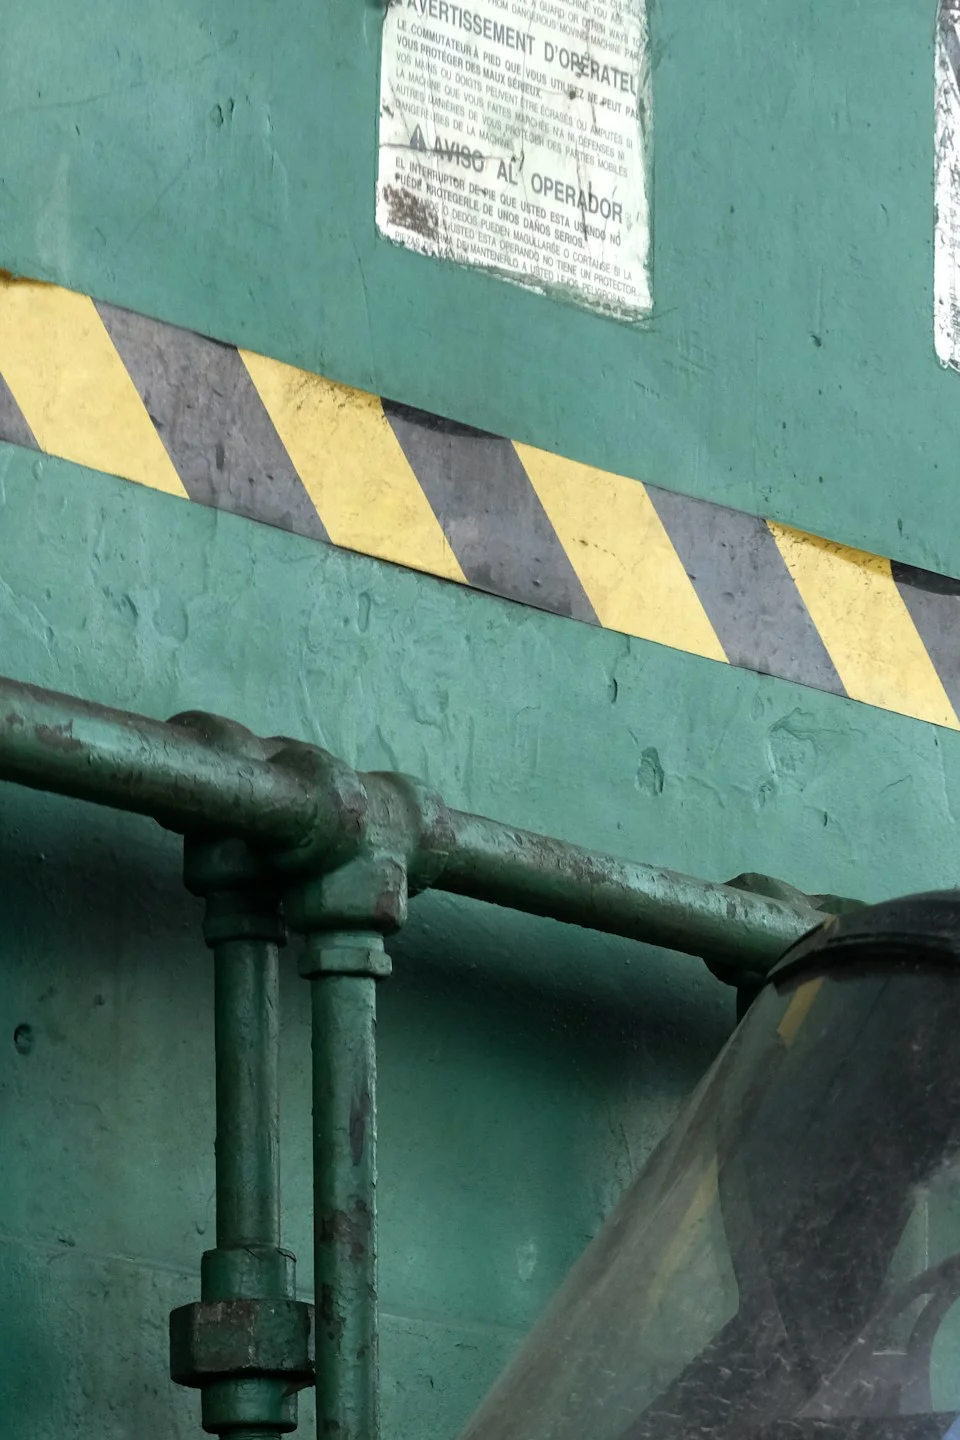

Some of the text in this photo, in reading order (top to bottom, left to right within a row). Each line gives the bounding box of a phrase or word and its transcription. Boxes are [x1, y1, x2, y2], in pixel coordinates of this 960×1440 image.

[512, 2, 555, 29] DANGEROUS
[539, 0, 564, 19] GUARD
[568, 10, 577, 25] OR
[396, 48, 410, 65] VOS
[415, 55, 436, 75] MAINS
[440, 65, 451, 81] OU
[455, 71, 481, 92] DOIGTS
[485, 83, 517, 106] PEUVENT
[576, 118, 586, 133] OU
[397, 32, 417, 52] VOUS
[420, 41, 462, 69] PROTÉGER
[465, 59, 480, 76] DES
[483, 66, 504, 86] MAUX
[397, 17, 620, 114] LE COMMUTATEUR À PIED QUE VOUS UTILISEZ NE PEUT
[396, 65, 404, 79] LA
[444, 84, 459, 100] QUE
[463, 91, 483, 109] VOUS
[487, 100, 511, 119] FAITES
[568, 131, 574, 144] NI
[618, 150, 624, 163] NI
[396, 81, 424, 102] AUTRES
[468, 108, 477, 122] DE
[481, 113, 501, 131] VOUS
[547, 139, 561, 154] DES
[598, 157, 627, 179] MOBILES
[453, 119, 462, 132] DE
[466, 123, 475, 137] LA
[395, 155, 404, 169] EL
[409, 160, 464, 190] INTERRUPTOR
[469, 181, 479, 195] DE
[485, 187, 495, 201] PIE
[500, 192, 516, 208] QUE
[520, 199, 545, 219] USTED
[550, 210, 569, 227] ESTA
[574, 219, 605, 240] USANDO
[433, 133, 622, 224] AVISO AL OPERADOR
[450, 222, 474, 240] USTED
[478, 231, 495, 247] ESTA
[499, 239, 539, 263] OPERANDO
[543, 254, 552, 267] NO
[557, 259, 576, 275] TIENE
[580, 267, 590, 280] UN
[452, 208, 477, 227] DEDOS
[480, 218, 509, 238] PUEDEN
[564, 248, 569, 259] O
[624, 269, 631, 281] LA
[483, 202, 493, 216] DE
[497, 207, 519, 225] UNOS
[523, 216, 550, 236] DAÑOS
[522, 261, 526, 272] A
[530, 264, 552, 281] USTED
